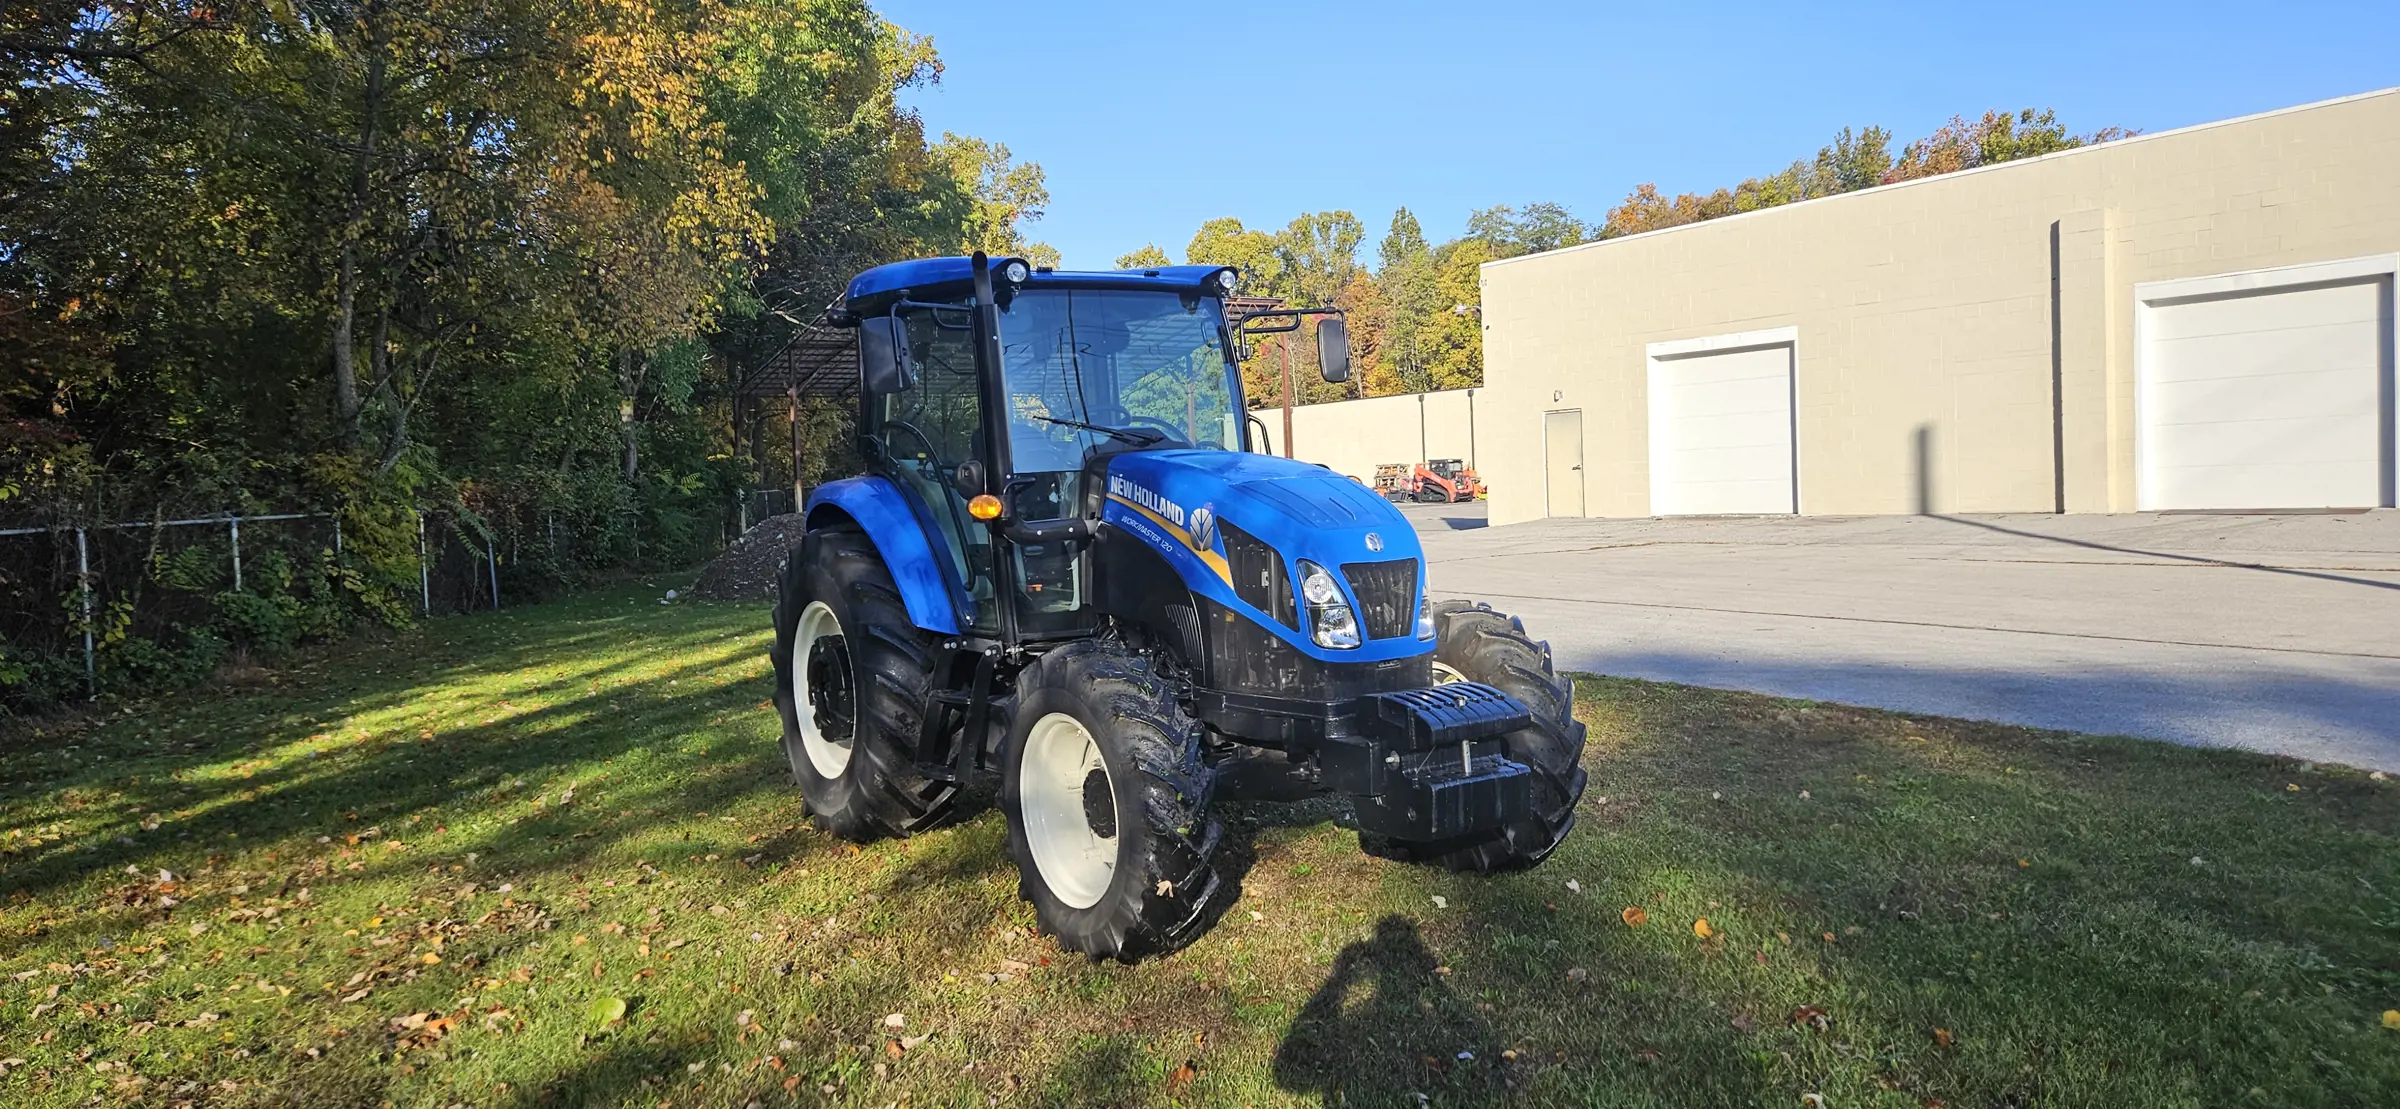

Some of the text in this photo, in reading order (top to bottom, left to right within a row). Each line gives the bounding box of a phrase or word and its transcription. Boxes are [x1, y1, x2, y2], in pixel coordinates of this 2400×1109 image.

[1110, 475, 1184, 527] NEW HOLLAND
[1121, 515, 1173, 552] WORKMASTER 120
